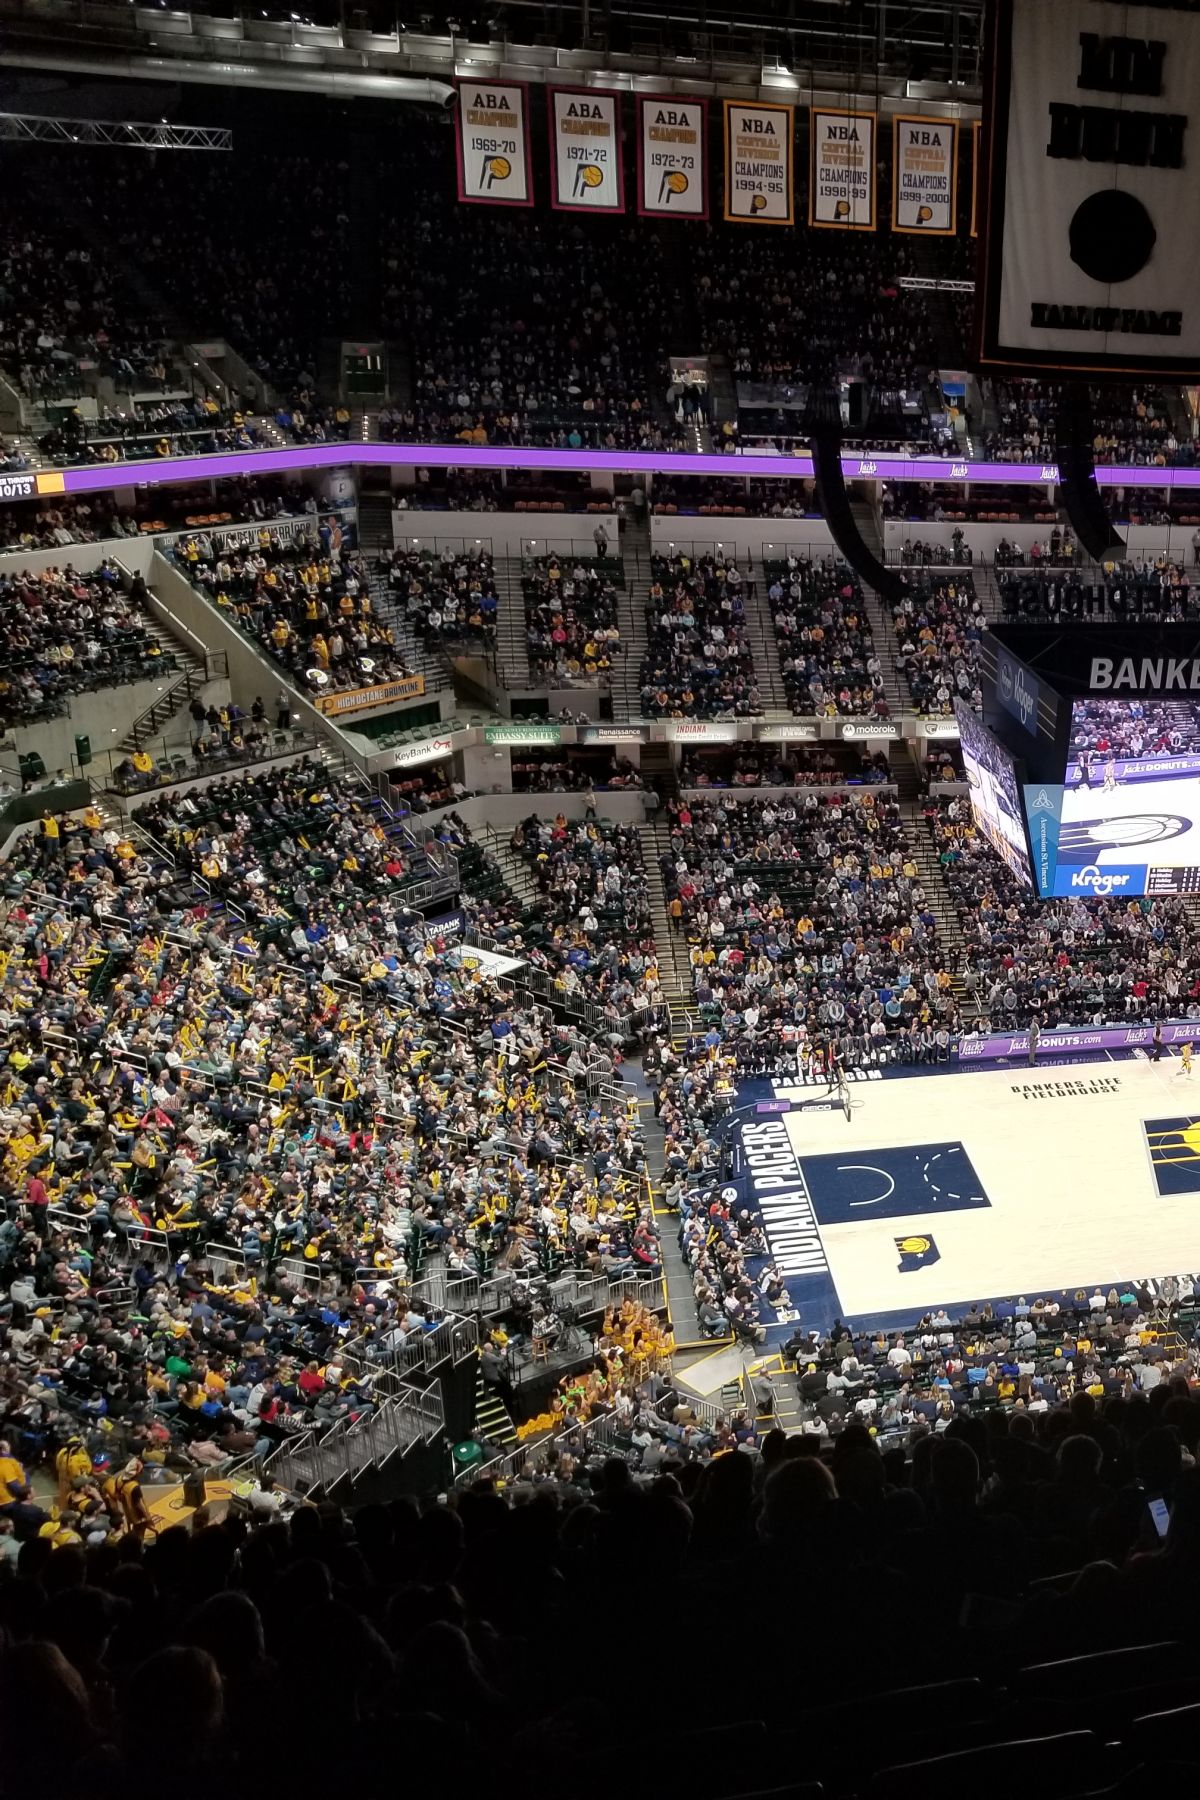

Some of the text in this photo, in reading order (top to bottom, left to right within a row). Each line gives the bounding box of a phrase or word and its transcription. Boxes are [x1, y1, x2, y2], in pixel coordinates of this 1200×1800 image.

[473, 93, 511, 110] ABA
[566, 103, 603, 119] ABA
[654, 110, 690, 126] ABA
[742, 118, 776, 135] NBA
[827, 126, 860, 141] NBA
[471, 137, 516, 153] 1969-70
[736, 136, 780, 149] CENTRAL
[909, 131, 942, 146] NBA
[567, 146, 607, 162] 1971-72
[821, 142, 865, 155] CENTRAL
[904, 147, 946, 160] CENTRAL
[651, 153, 694, 169] 1972-73
[735, 161, 784, 179] CHAMPIONS
[819, 167, 867, 185] CHAMPIONS
[735, 179, 783, 193] 1994-95
[902, 173, 947, 190] CHAMPIONS
[819, 185, 866, 199] 1998-99
[899, 191, 949, 204] 1999-2000
[1031, 302, 1182, 335] HALL OF FAME
[336, 695, 356, 709] HIGH
[356, 689, 384, 706] OCTANE
[1014, 667, 1034, 724] Kroger
[485, 731, 561, 740] EMBASSY SUITES
[676, 725, 707, 734] INDIANA
[856, 725, 896, 734] motorola
[395, 744, 432, 762] KeyBank
[1040, 817, 1048, 849] Ascension
[1041, 849, 1049, 861] St.
[1071, 865, 1130, 895] Kroger
[1124, 1028, 1148, 1043] Jack's
[960, 1041, 985, 1055] Jack's
[1011, 1077, 1123, 1093] BANKERS LIFE
[1023, 1085, 1120, 1100] FIELDHOUSE
[801, 1104, 832, 1112] GEICO
[742, 1120, 828, 1277] INDIANA PACERS
